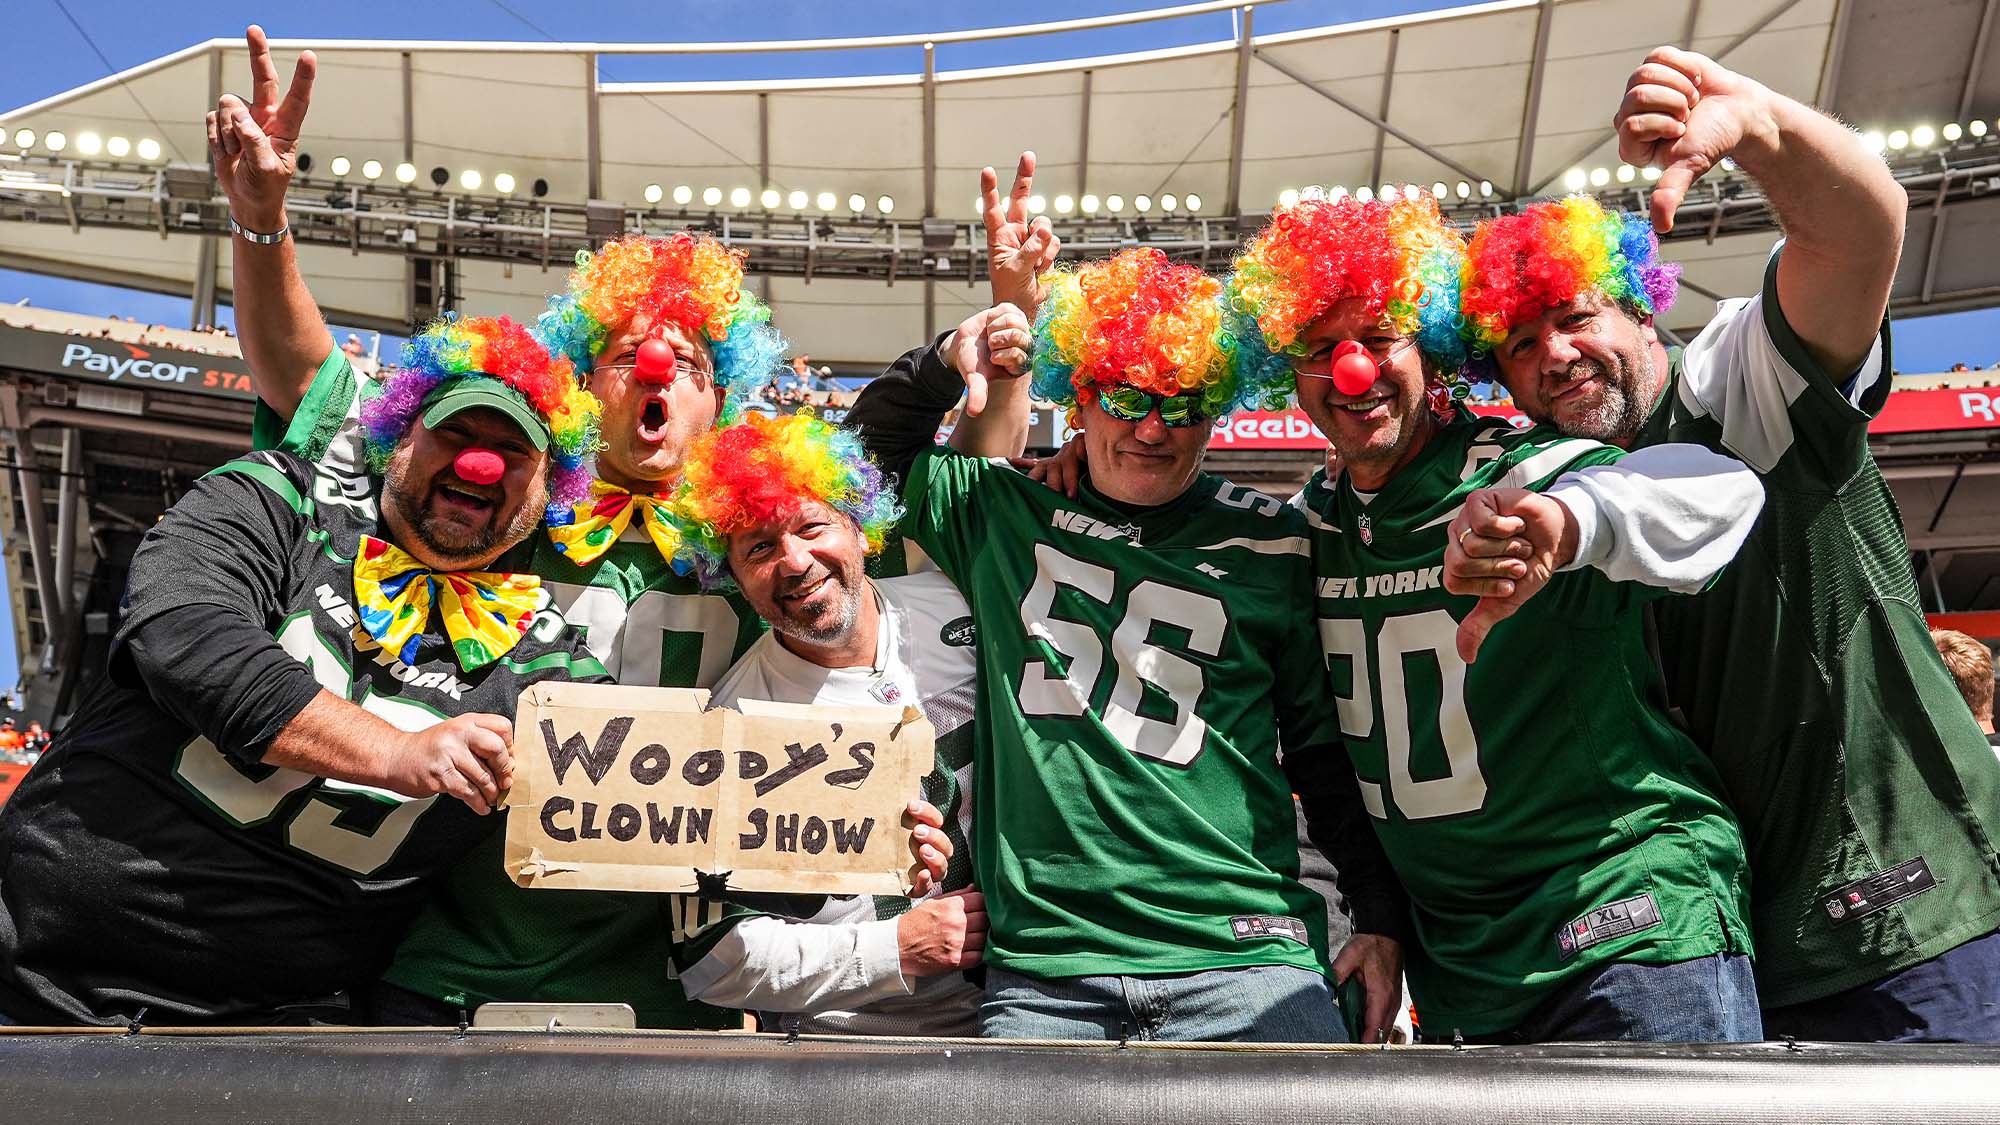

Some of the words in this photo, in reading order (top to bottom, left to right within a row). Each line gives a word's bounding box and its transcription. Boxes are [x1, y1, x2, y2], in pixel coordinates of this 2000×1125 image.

[61, 343, 199, 383] Paycor
[203, 370, 255, 391] STA
[1363, 565, 1444, 598] YORK
[1018, 542, 1228, 768] 56
[540, 796, 713, 845] CLOWN
[739, 807, 875, 854] SHOW
[1596, 908, 1621, 924] XL
